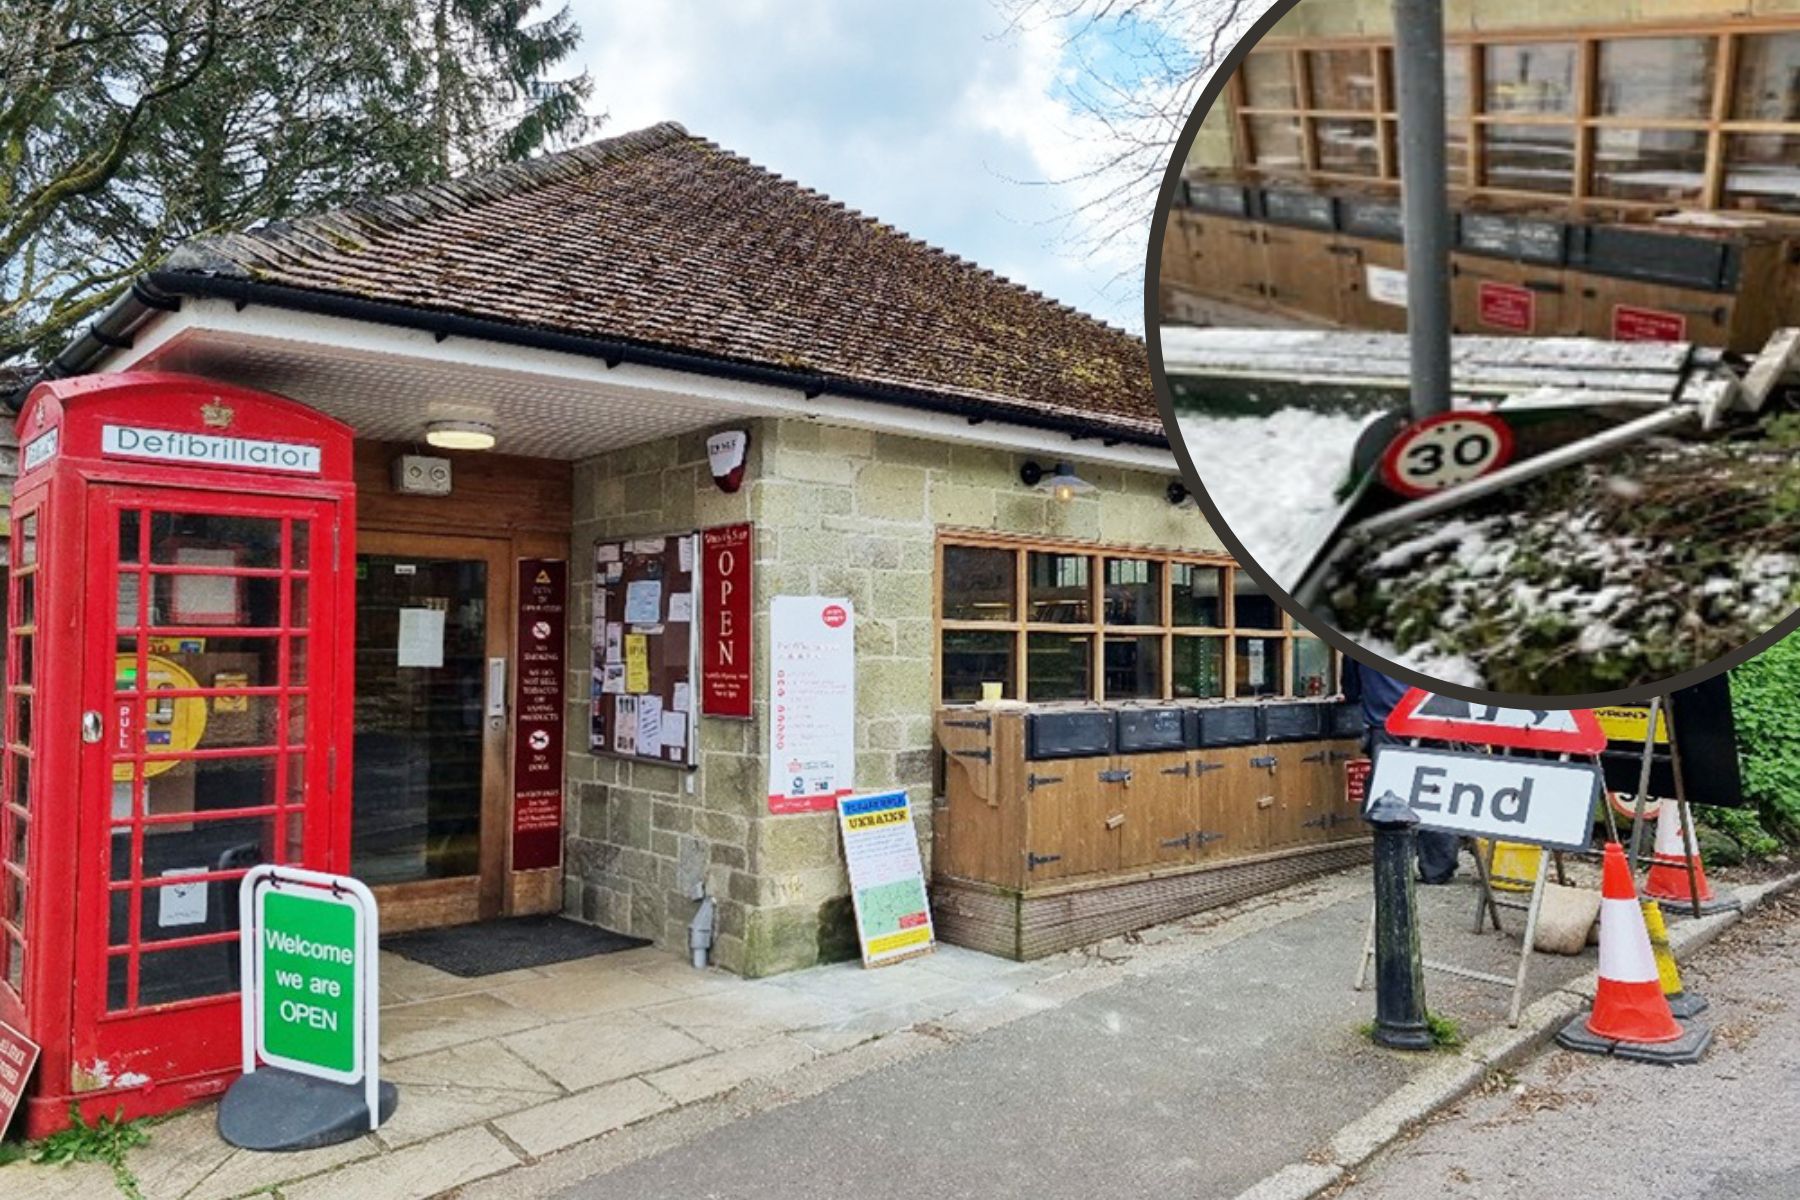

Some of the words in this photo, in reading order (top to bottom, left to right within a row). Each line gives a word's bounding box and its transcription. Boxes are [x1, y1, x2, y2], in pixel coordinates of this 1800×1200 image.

[117, 428, 310, 467] Defibrillator
[1407, 434, 1491, 476] 30
[718, 550, 735, 666] OPEN
[120, 705, 131, 749] PULL
[1409, 765, 1534, 824] End
[265, 928, 353, 965] Welcome
[275, 969, 303, 990] we
[309, 977, 341, 998] are
[279, 1000, 338, 1032] OPEN
